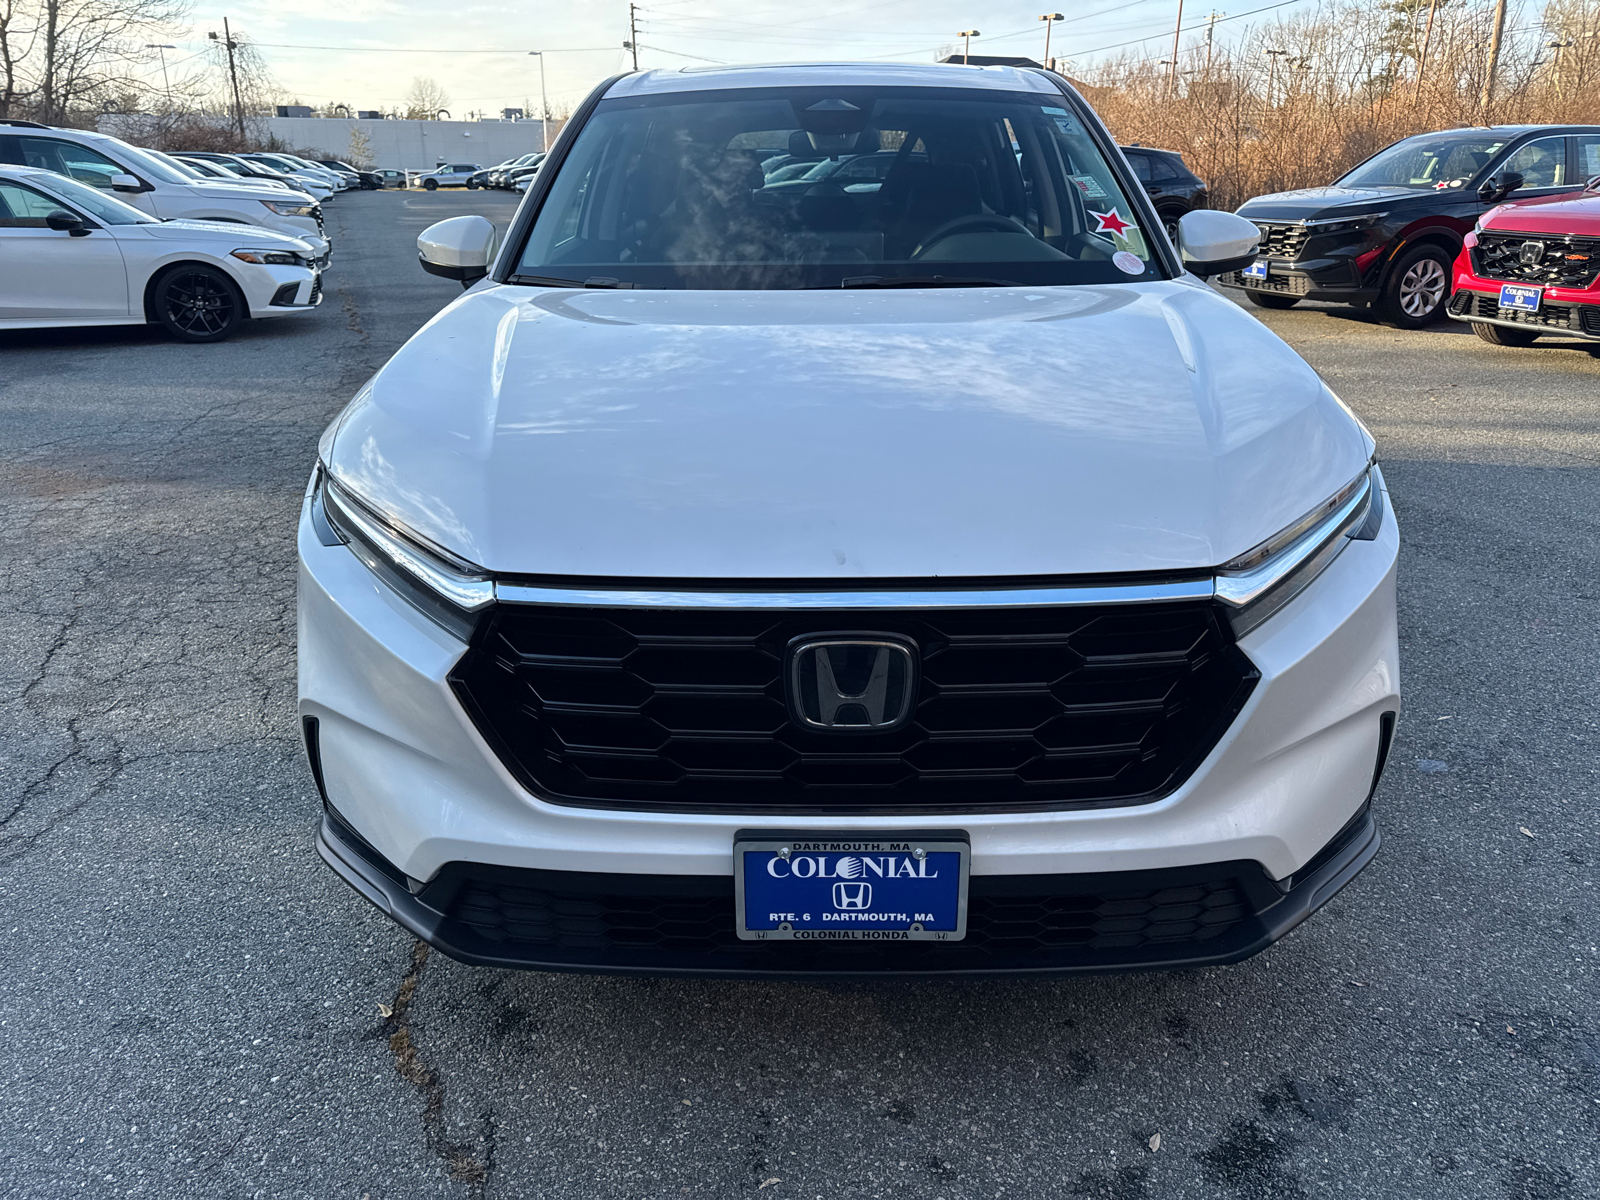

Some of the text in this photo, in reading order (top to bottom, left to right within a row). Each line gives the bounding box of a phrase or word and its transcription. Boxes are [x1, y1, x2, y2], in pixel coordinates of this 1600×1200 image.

[793, 843, 911, 851] DARTMOUTH, MA
[766, 856, 939, 879] COLONIAL
[769, 913, 935, 922] RTE. 6 DARTMOUTH, MA
[793, 931, 909, 940] COLONIAL HONDA
